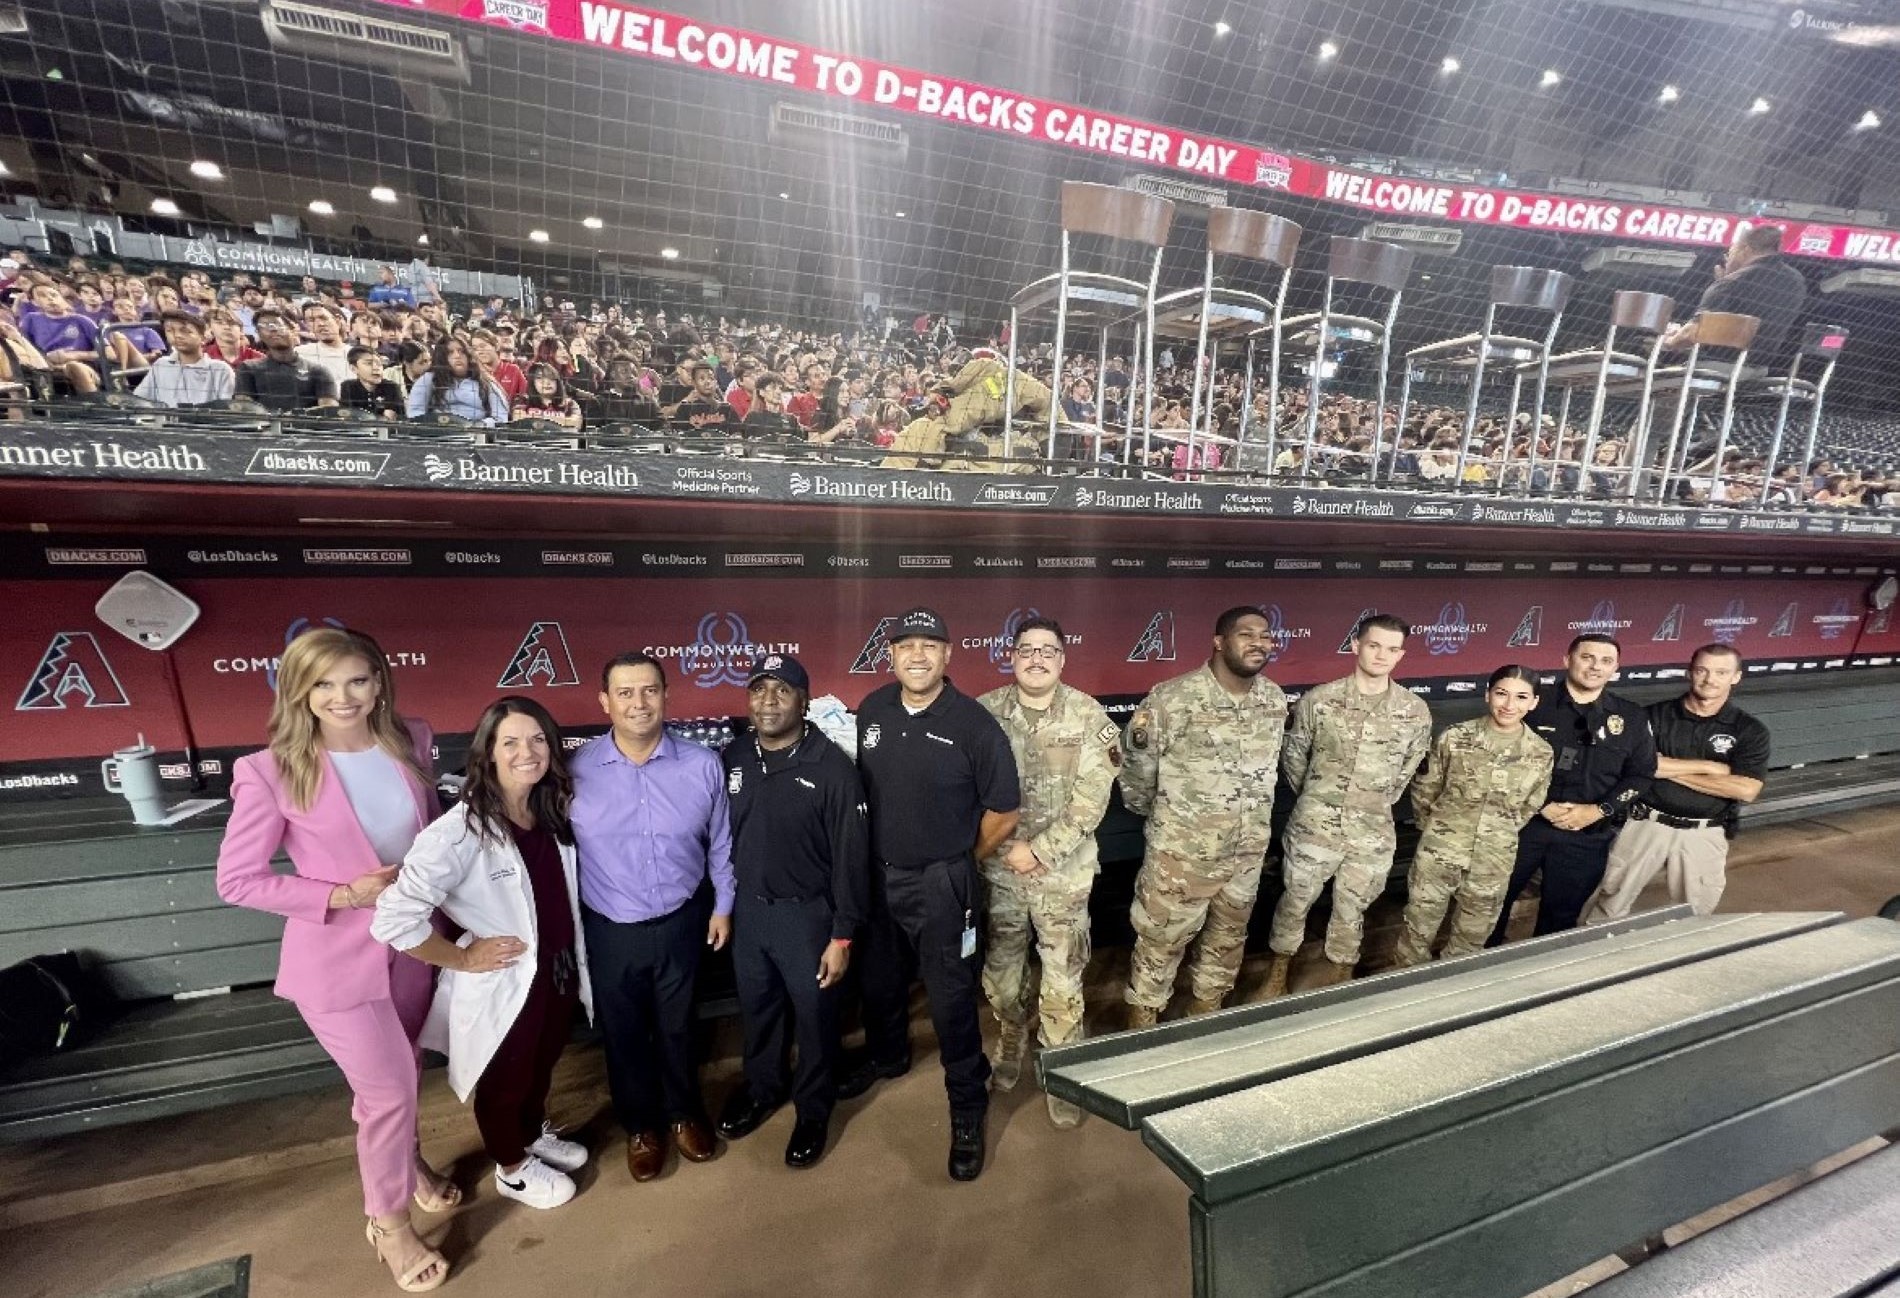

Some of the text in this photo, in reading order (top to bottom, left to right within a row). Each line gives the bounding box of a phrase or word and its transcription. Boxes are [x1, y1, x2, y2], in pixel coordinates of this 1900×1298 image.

[580, 1, 800, 85] WELCOME
[813, 55, 863, 97] TO
[874, 70, 1039, 134] D-BACKS
[1045, 109, 1172, 164] CAREER
[1176, 138, 1237, 176] DAY
[1324, 170, 1452, 216] WELCOME
[1460, 190, 1495, 220] TO
[1500, 201, 1623, 233] D-BACKS
[1624, 211, 1729, 244] CAREER
[217, 247, 366, 275] COMMONWEALTH
[0, 443, 207, 471] nner Health
[458, 458, 639, 488] Banner Health
[676, 467, 752, 482] Official Sports
[672, 480, 761, 495] Medicine Partner
[814, 476, 953, 501] Banner Health
[1095, 490, 1202, 510] Banner Health
[1308, 498, 1395, 516] Banner Health
[50, 550, 143, 562] DBACKS.COM
[187, 549, 279, 563] @LosDbacks
[445, 550, 501, 564] @Dbacks
[642, 553, 707, 566] @LosDbacks
[961, 634, 1083, 649] COMMOTH
[642, 642, 801, 659] COMMONWEALTH
[213, 652, 427, 672] COMMLTH
[0, 773, 79, 789] LosDbacks
